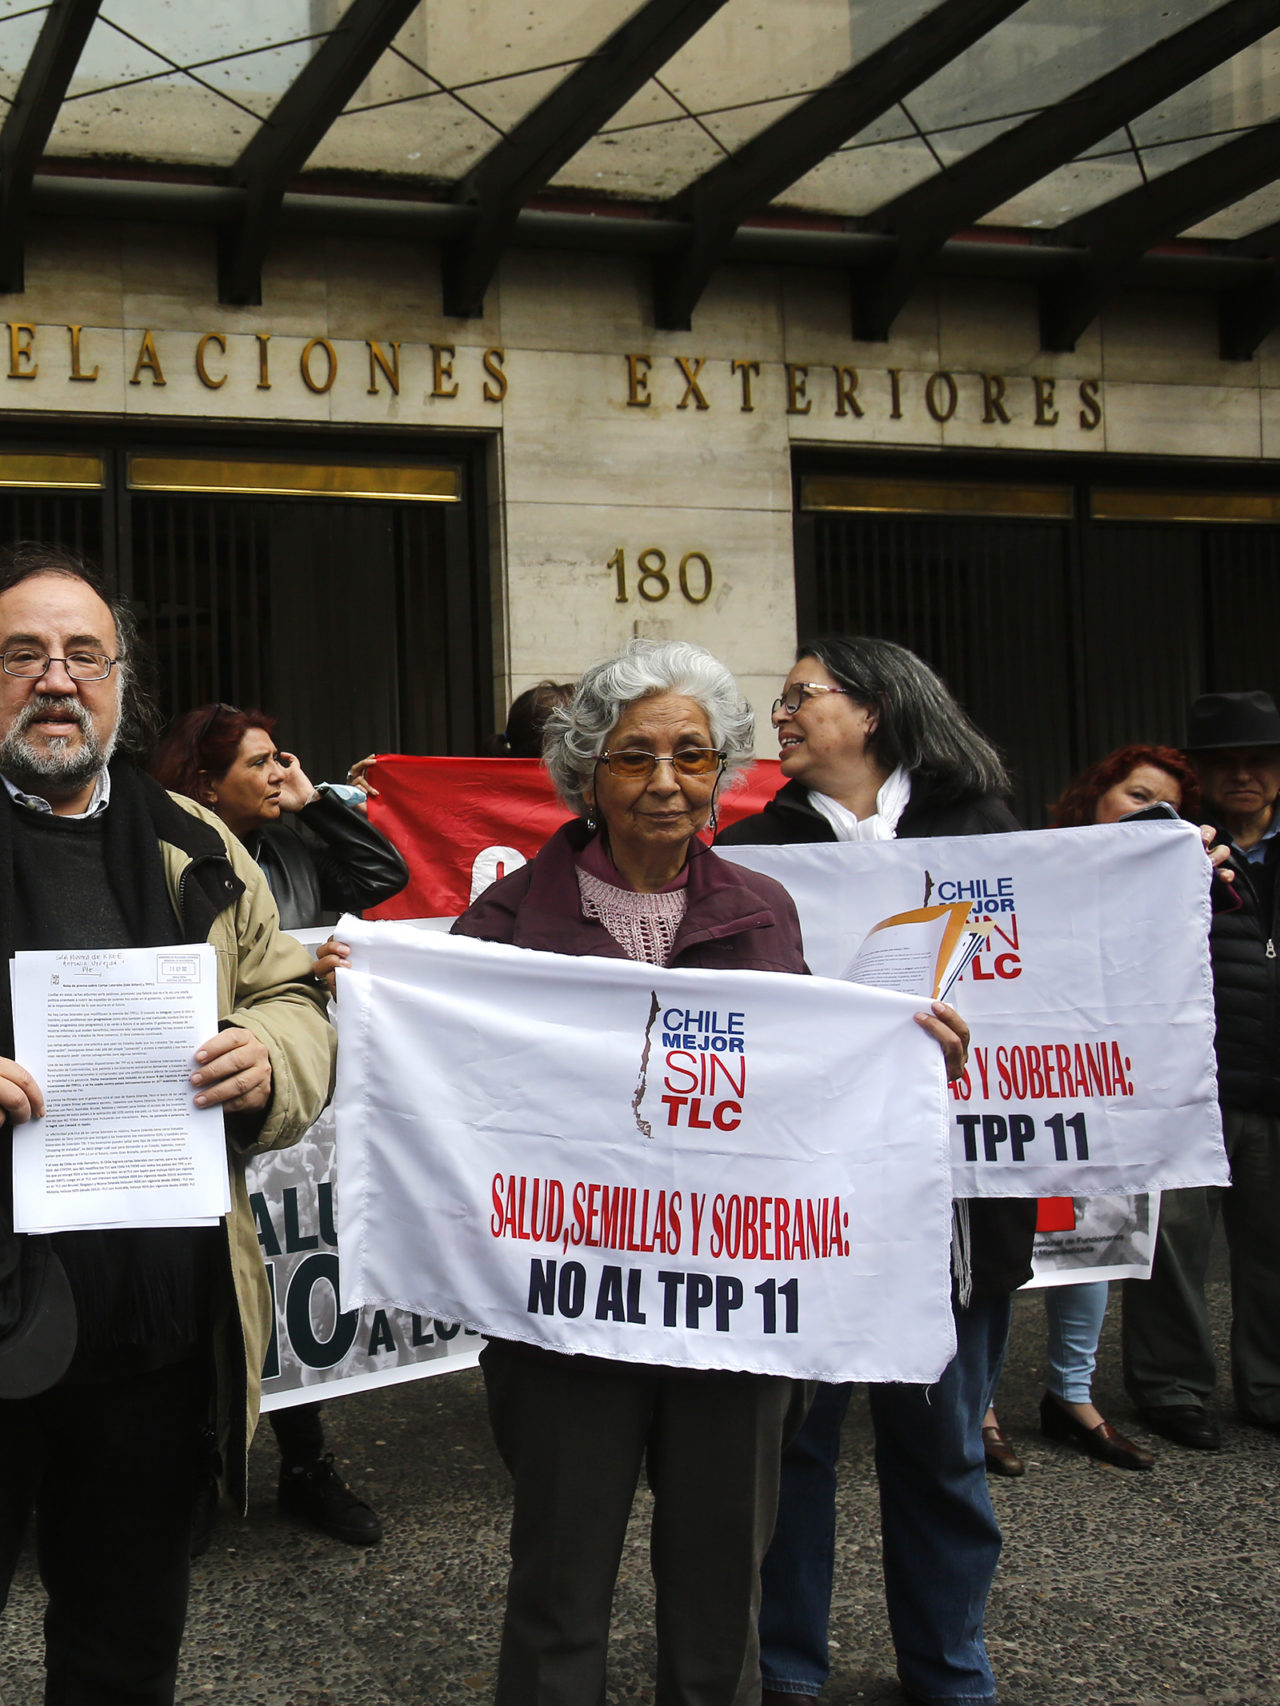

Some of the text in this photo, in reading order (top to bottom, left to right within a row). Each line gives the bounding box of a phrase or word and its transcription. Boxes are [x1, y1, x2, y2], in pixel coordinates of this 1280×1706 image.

[624, 354, 1104, 431] EXTERIORES
[606, 546, 713, 604] 180
[937, 877, 1015, 900] CHILE
[939, 898, 1016, 914] JOR
[958, 952, 1023, 981] LC
[662, 1032, 744, 1053] MEJOR
[663, 1008, 745, 1035] CHILE
[664, 1050, 746, 1099] SIN
[974, 1046, 990, 1100] Y
[995, 1040, 1134, 1101] SOBERANIA:
[661, 1094, 742, 1131] TLC
[956, 1112, 1089, 1162] TPP 11
[691, 1193, 707, 1256] Y
[710, 1193, 850, 1261] SOBERANIA:
[527, 1258, 800, 1334] NO AL TPP 11
[368, 1309, 397, 1357] A
